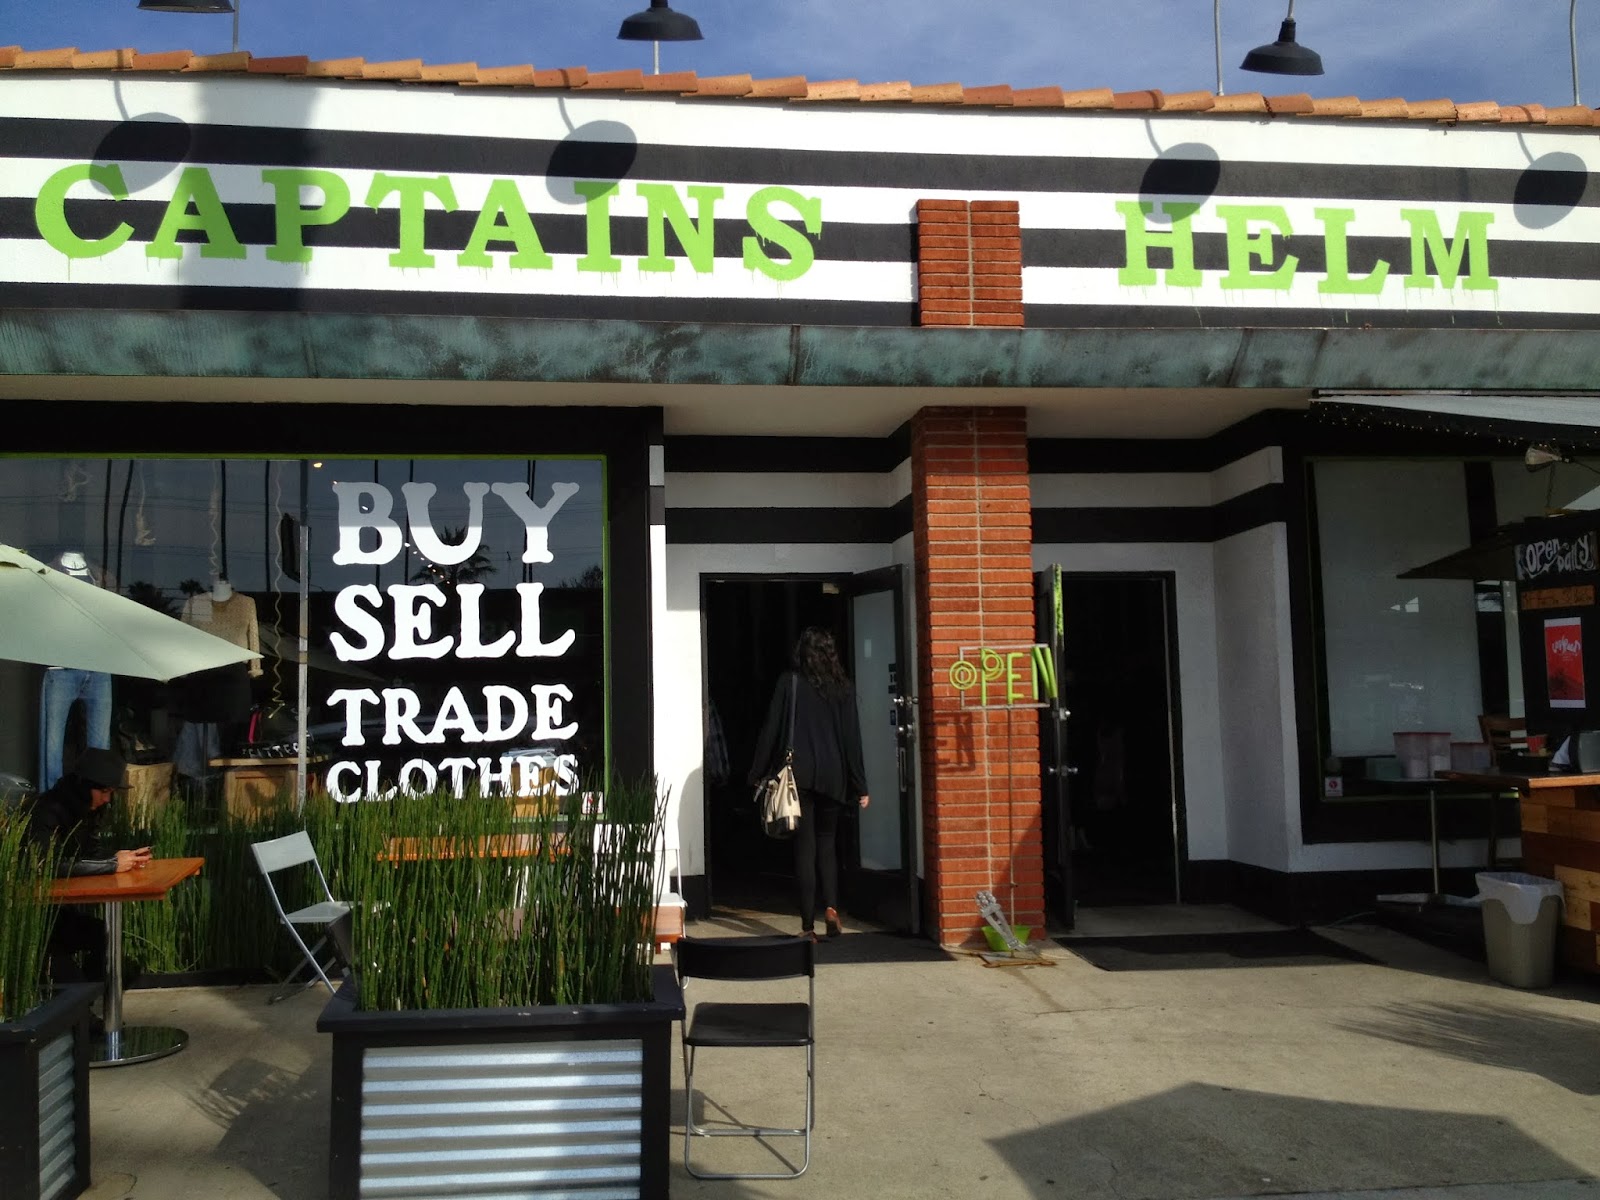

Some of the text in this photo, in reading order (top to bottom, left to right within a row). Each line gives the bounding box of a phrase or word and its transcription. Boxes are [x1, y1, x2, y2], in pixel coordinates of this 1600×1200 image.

[34, 162, 1499, 296] CAPTAINS HELM
[331, 481, 581, 566] BUY
[328, 582, 577, 662] SELL
[949, 645, 1059, 708] OPEN
[325, 683, 580, 747] TRADE
[325, 753, 580, 804] CLOTHES
